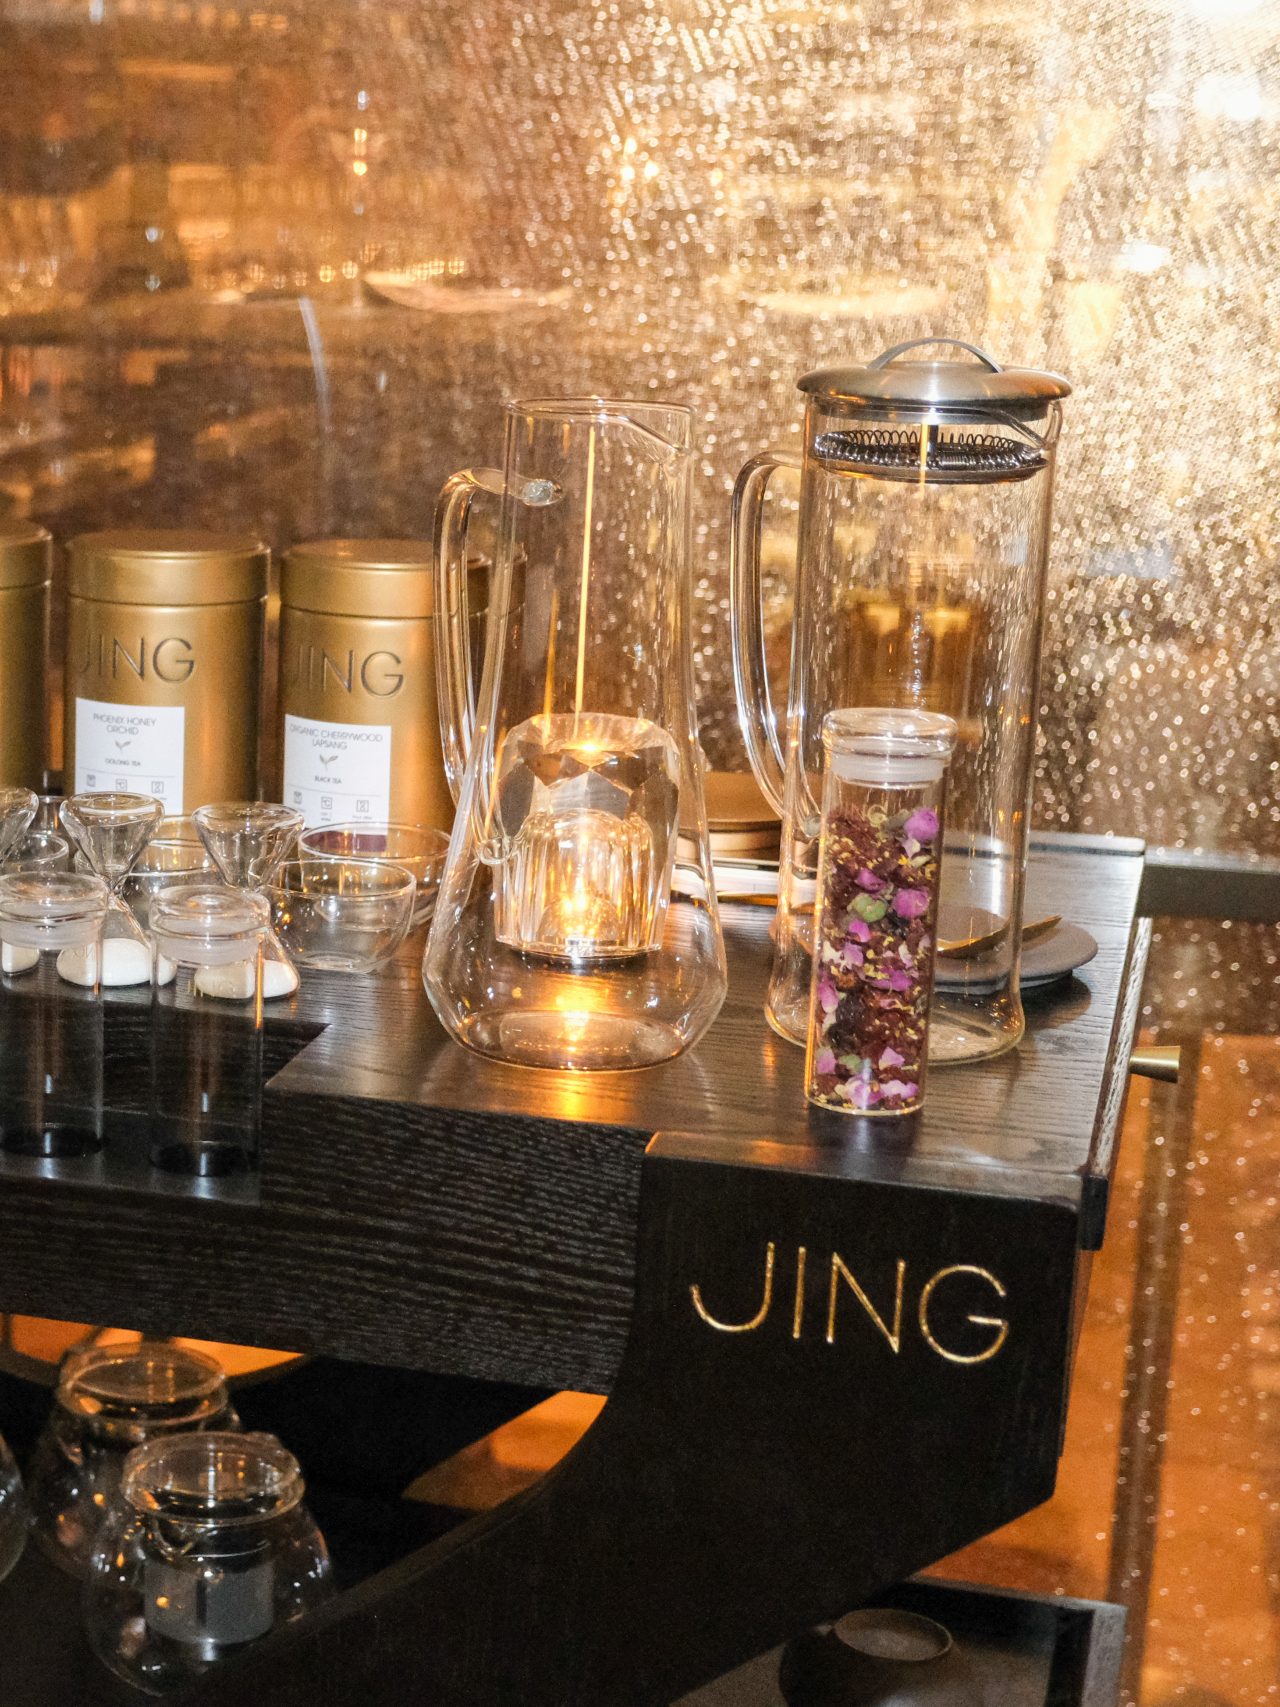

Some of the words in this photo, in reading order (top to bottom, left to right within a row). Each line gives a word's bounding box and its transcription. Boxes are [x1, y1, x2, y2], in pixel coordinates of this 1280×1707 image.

[77, 635, 195, 683] JING
[93, 713, 125, 724] PHOENIX
[127, 717, 157, 727] HONEY
[106, 724, 139, 735] ORCHID
[289, 723, 320, 737] ORGANIC
[320, 729, 383, 742] CHERRYWOOD
[312, 739, 348, 750] LAPSANG
[690, 1242, 1010, 1364] JING
